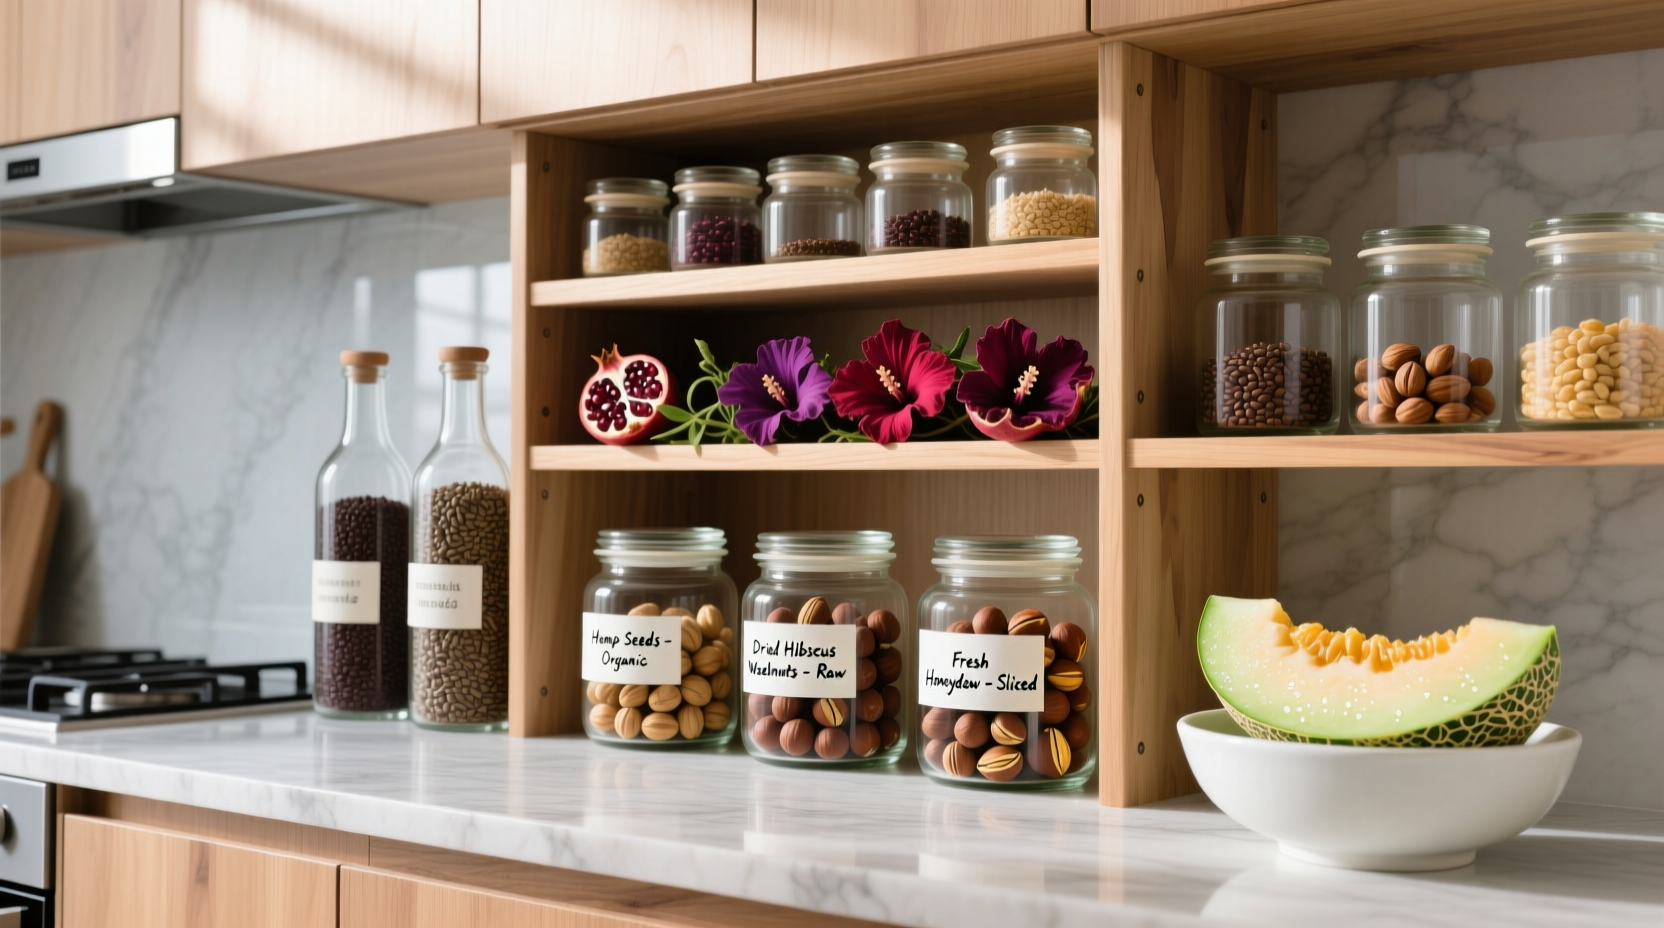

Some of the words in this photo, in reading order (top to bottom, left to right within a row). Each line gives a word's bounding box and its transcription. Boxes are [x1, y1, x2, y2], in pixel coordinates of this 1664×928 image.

[624, 631, 661, 648] Seeds
[752, 639, 780, 656] Dried
[602, 650, 648, 672] Organic
[952, 651, 989, 669] Fresh
[816, 662, 847, 679] Raw
[996, 673, 1038, 691] Sliced
